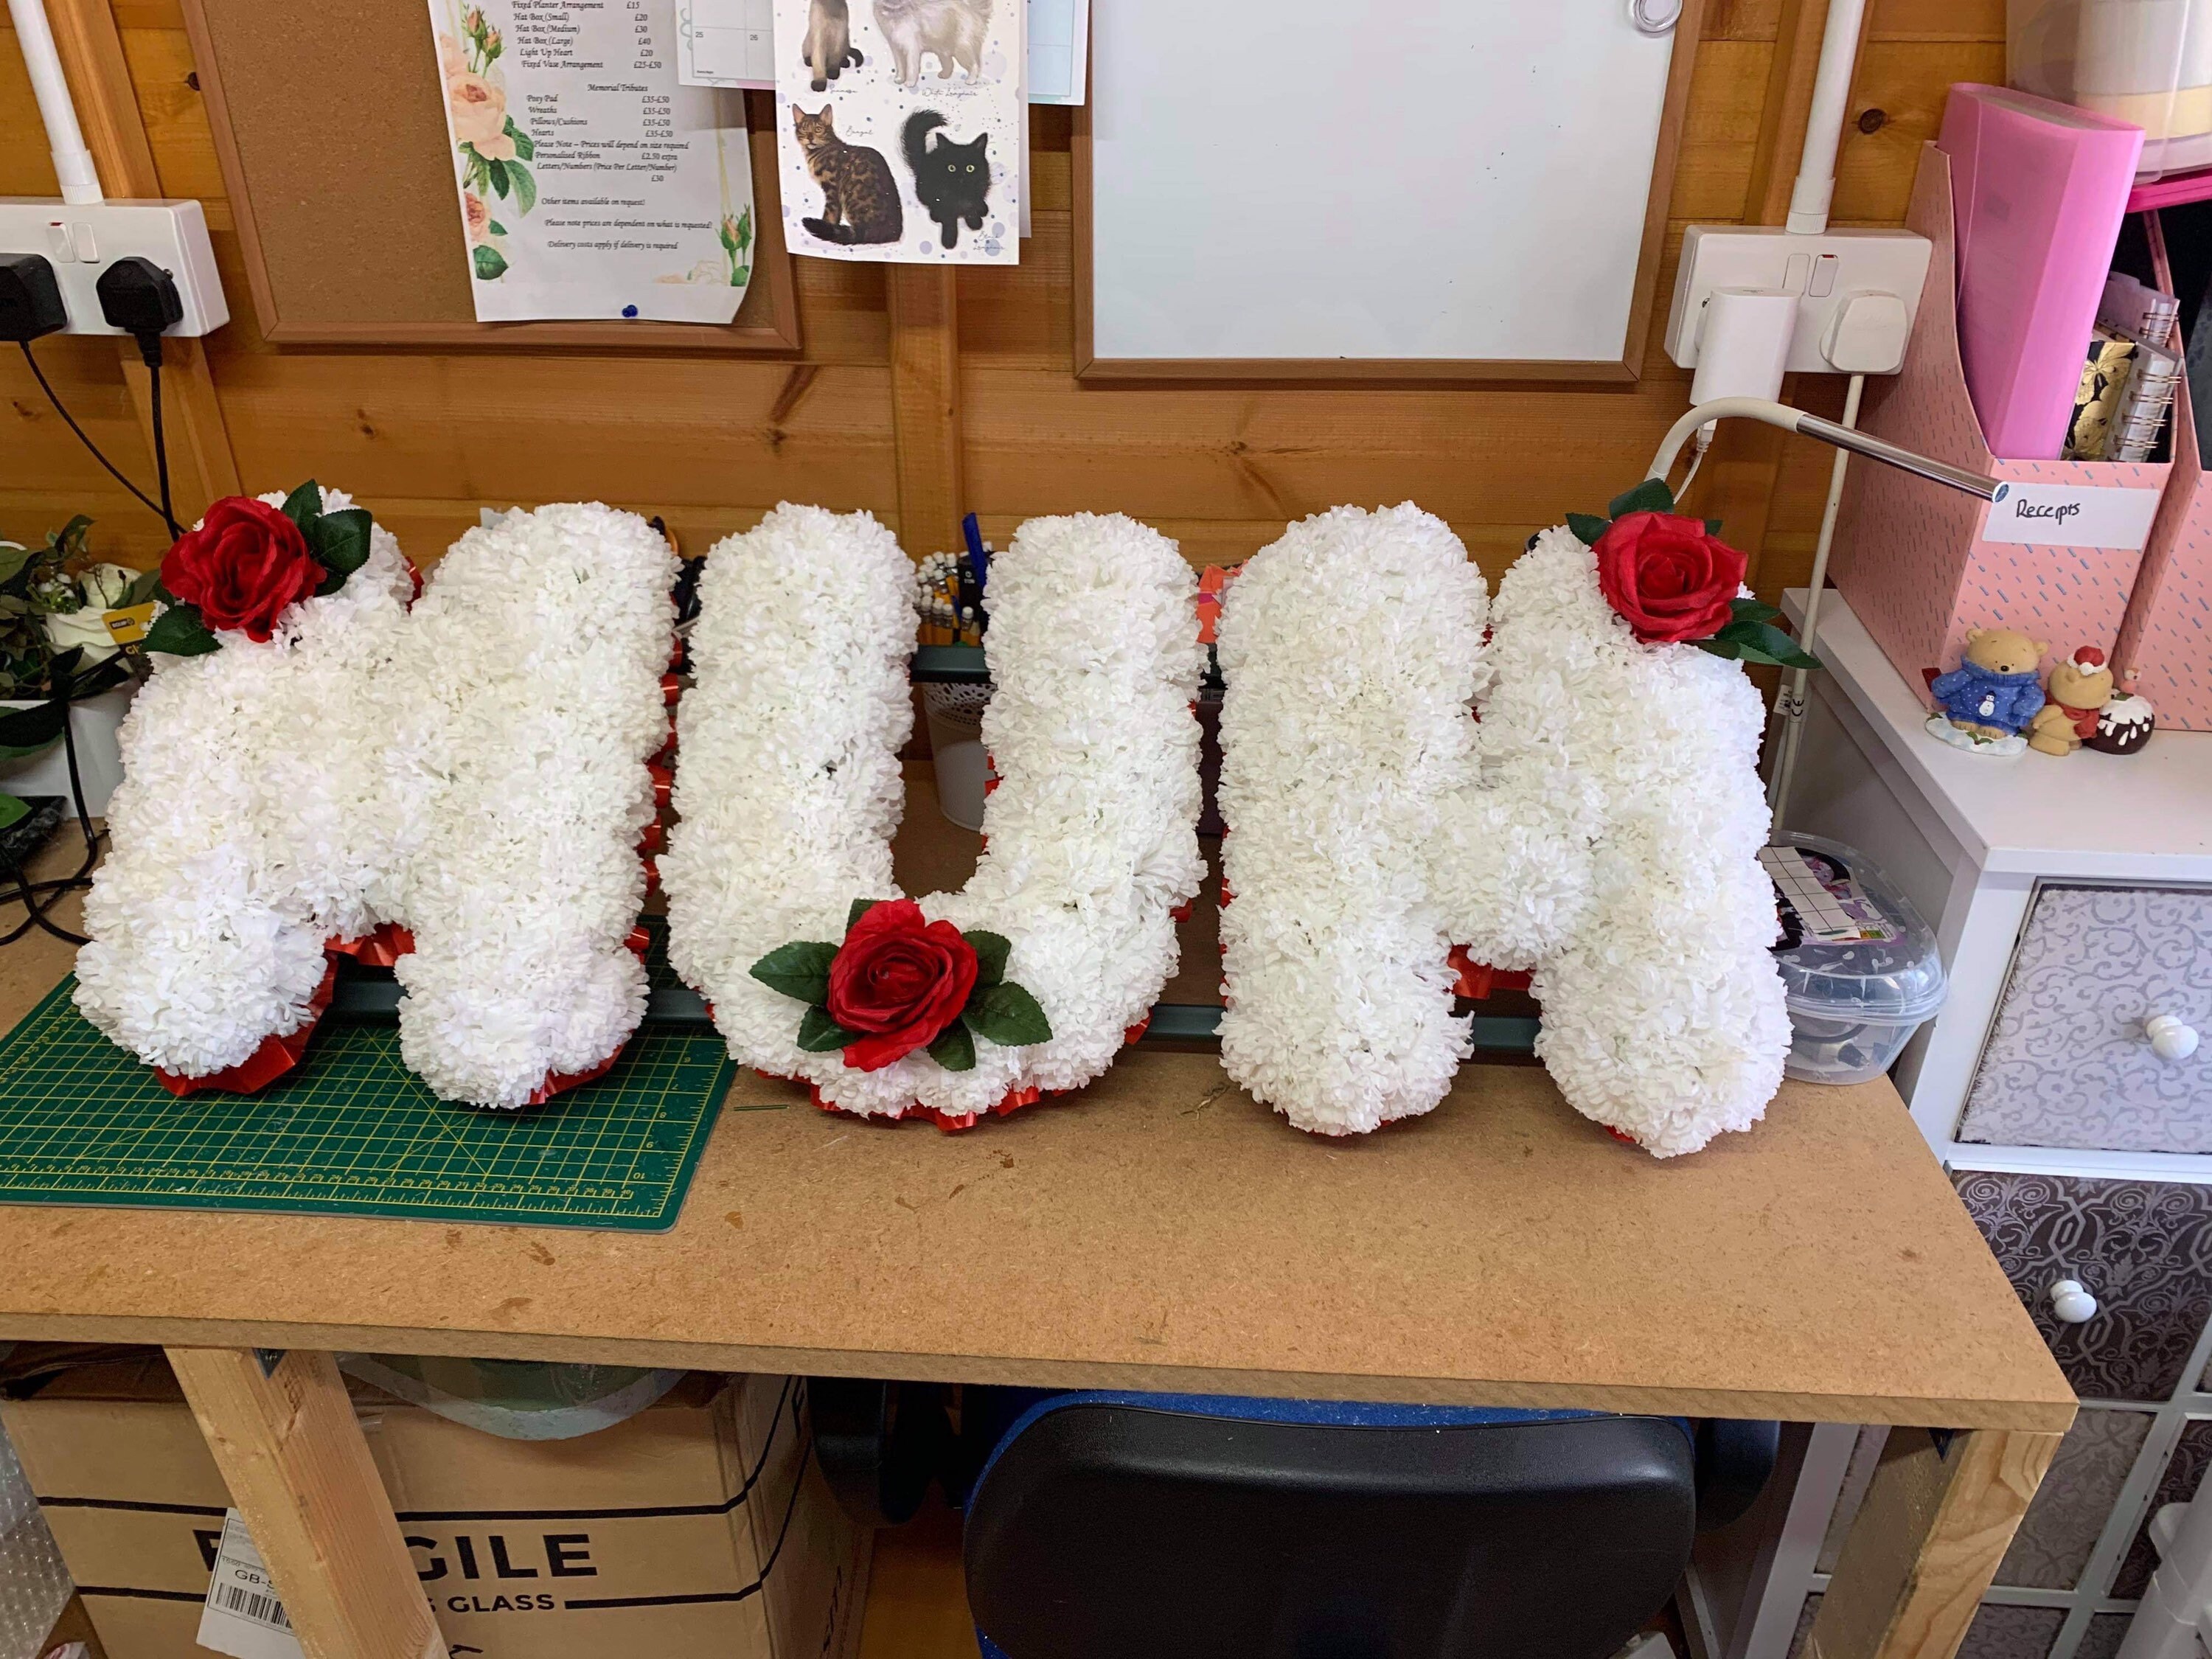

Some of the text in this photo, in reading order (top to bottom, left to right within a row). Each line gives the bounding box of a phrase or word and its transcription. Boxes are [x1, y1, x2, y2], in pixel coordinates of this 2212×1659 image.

[529, 13, 545, 22] Box
[545, 13, 569, 22] (Small)
[532, 25, 546, 33] Box
[546, 25, 580, 35] (Medium)
[533, 38, 548, 46] Box
[548, 37, 573, 46] (Large)
[520, 49, 538, 58] Light
[541, 49, 552, 58] Up
[522, 60, 540, 69] Fixed
[560, 60, 603, 70] Arrangement
[192, 1529, 598, 1582] FGILE
[447, 1593, 555, 1613] GLASS
